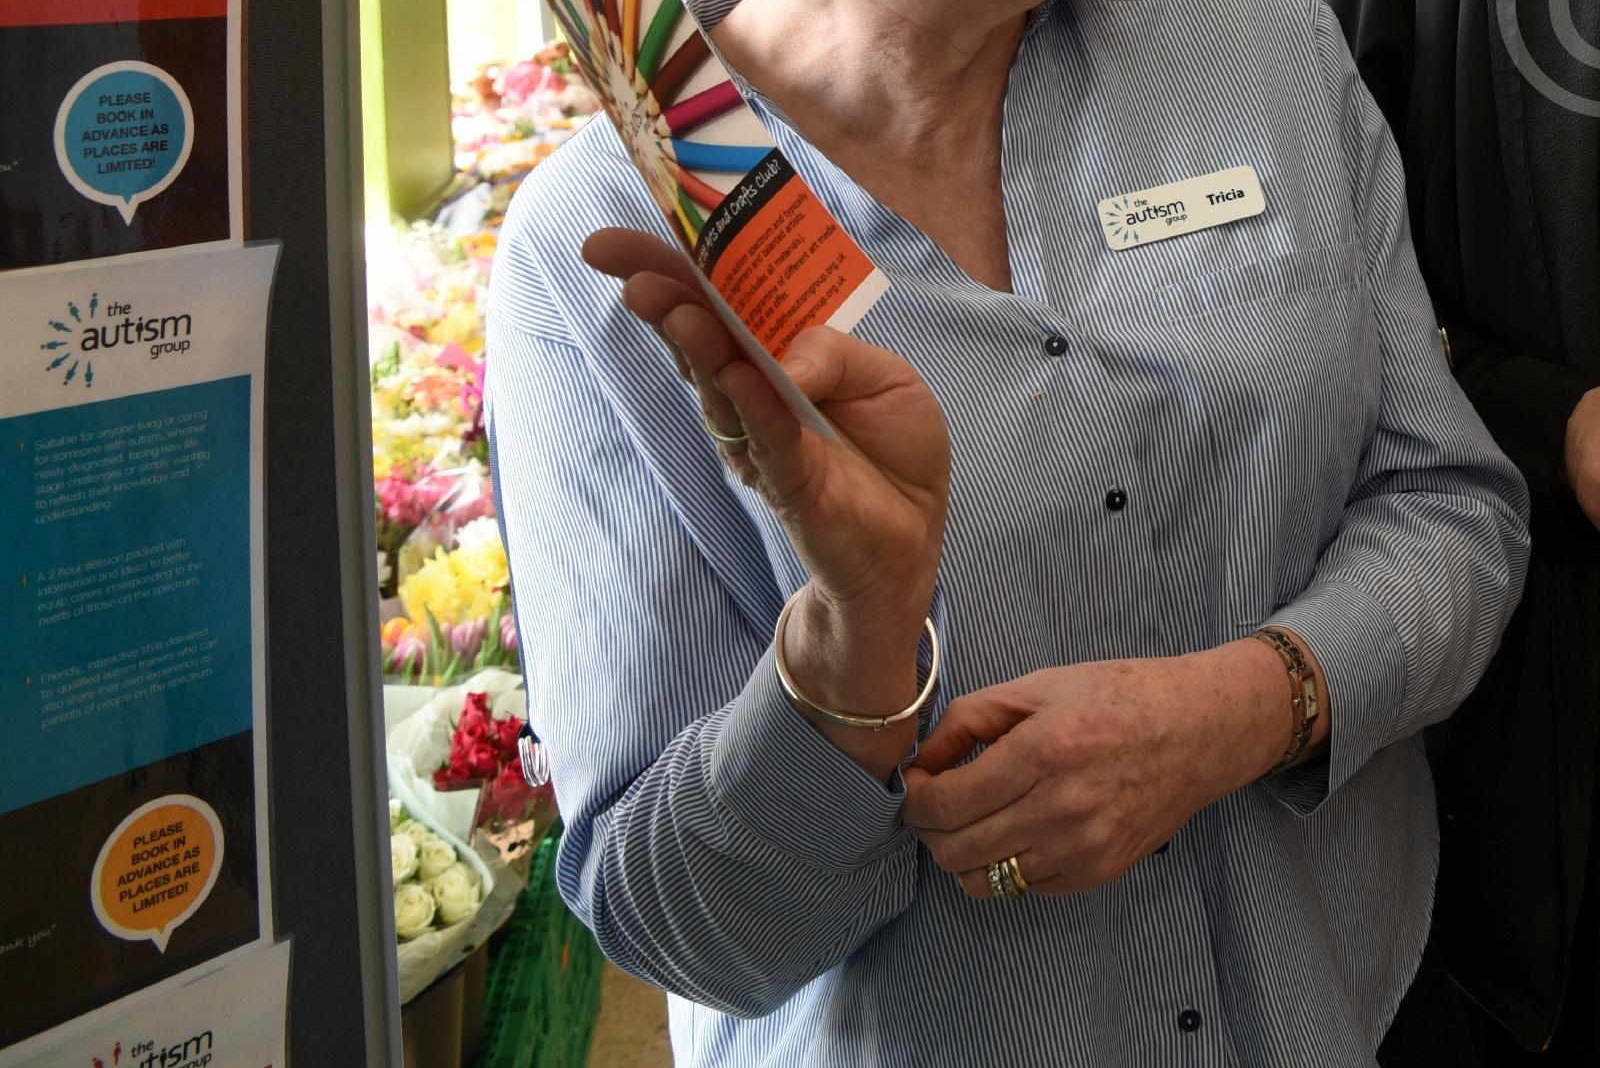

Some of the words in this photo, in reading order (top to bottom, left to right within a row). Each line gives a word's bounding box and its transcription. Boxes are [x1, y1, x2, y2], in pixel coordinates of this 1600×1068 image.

[99, 92, 151, 106] PLEASE
[97, 110, 137, 124] BOOK
[140, 108, 154, 120] IN
[81, 126, 148, 143] ADVANCE
[151, 123, 169, 136] AS
[83, 143, 137, 159] PLACES
[141, 140, 169, 153] ARE
[97, 158, 156, 175] LIMITED!
[716, 207, 732, 229] and
[729, 182, 758, 216] Crafts
[755, 159, 784, 188] Club?
[1134, 199, 1148, 208] the
[1206, 188, 1245, 206] Tricia
[1126, 200, 1185, 226] autism
[1165, 213, 1187, 227] group
[107, 302, 132, 318] the
[80, 312, 192, 352] autism
[150, 339, 191, 361] group
[133, 821, 184, 849] PLEASE
[131, 840, 170, 866] BOOK
[173, 835, 187, 850] IN
[117, 854, 180, 888] ADVANCE
[183, 846, 201, 861] AS
[119, 874, 171, 904] PLACES
[174, 861, 201, 882] ARE
[132, 882, 189, 914] LIMITED!
[131, 1040, 154, 1058] the
[140, 1030, 213, 1068] tism
